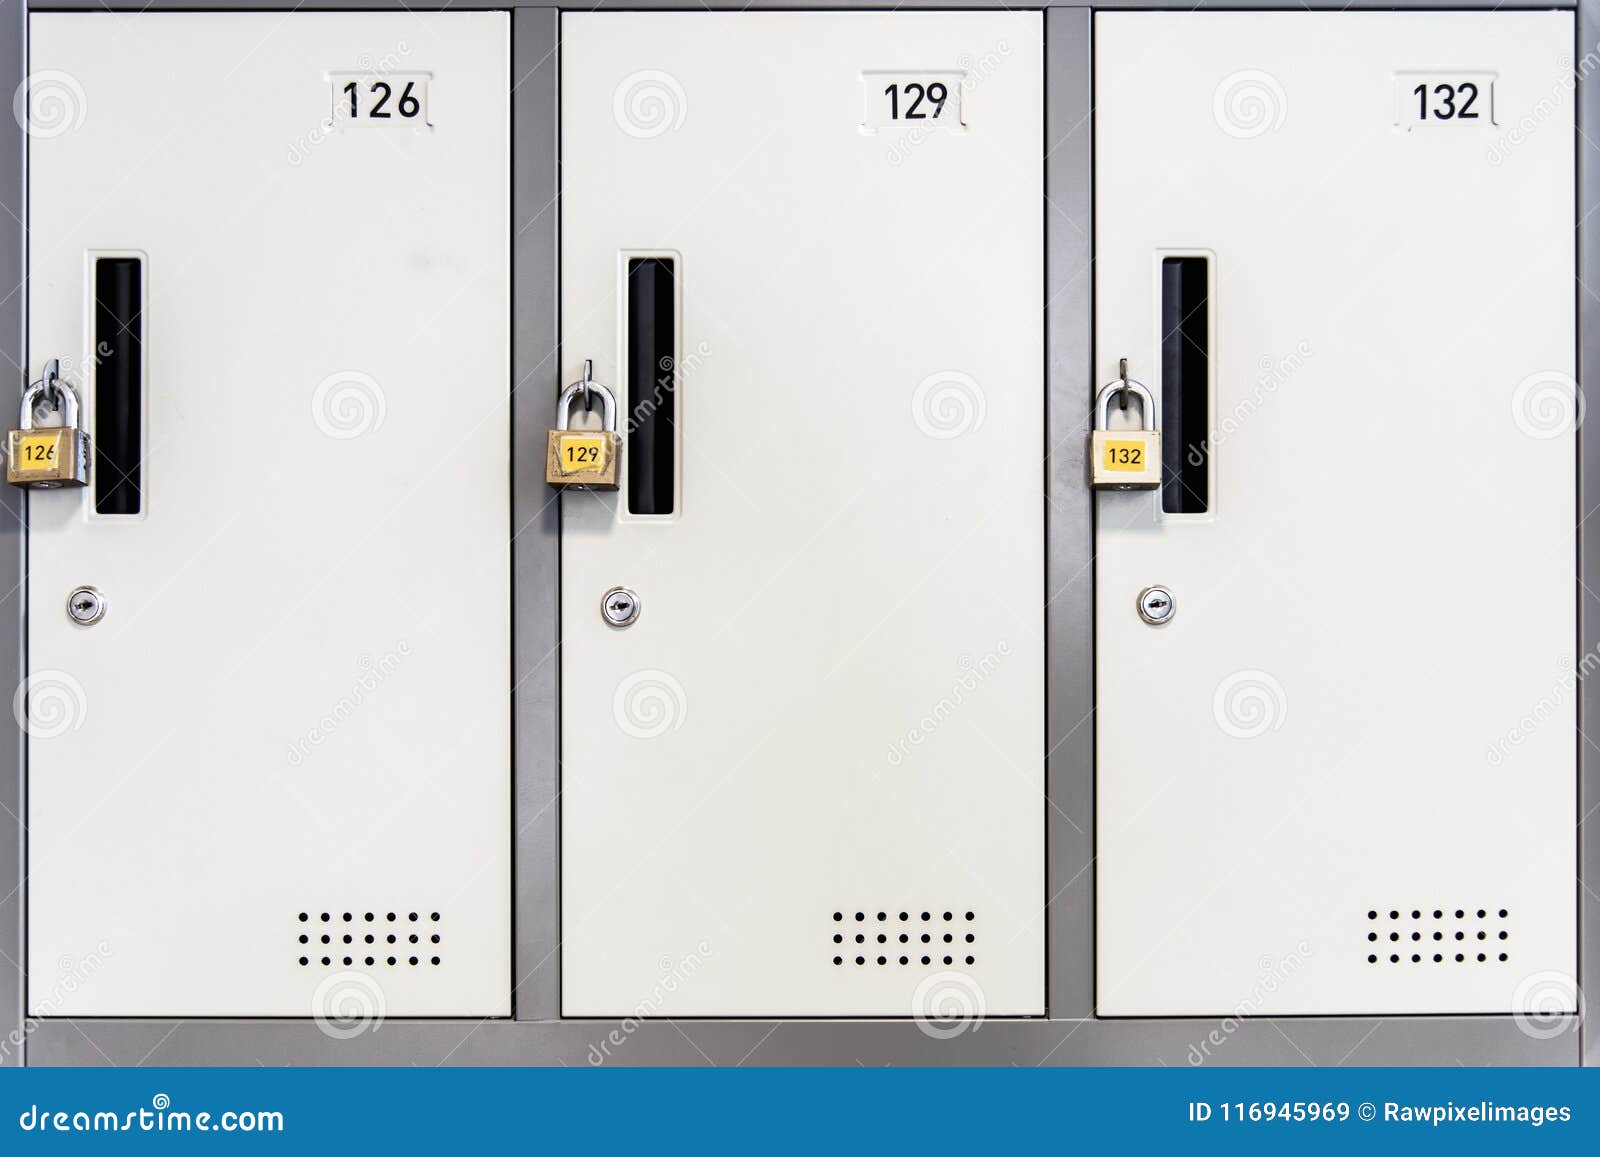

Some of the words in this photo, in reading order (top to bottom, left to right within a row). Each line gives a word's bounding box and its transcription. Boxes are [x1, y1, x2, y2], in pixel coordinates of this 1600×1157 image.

[343, 81, 420, 118] 126
[885, 82, 948, 119] 129
[1414, 82, 1479, 120] 132
[567, 446, 599, 462] 129
[1108, 448, 1141, 464] 132
